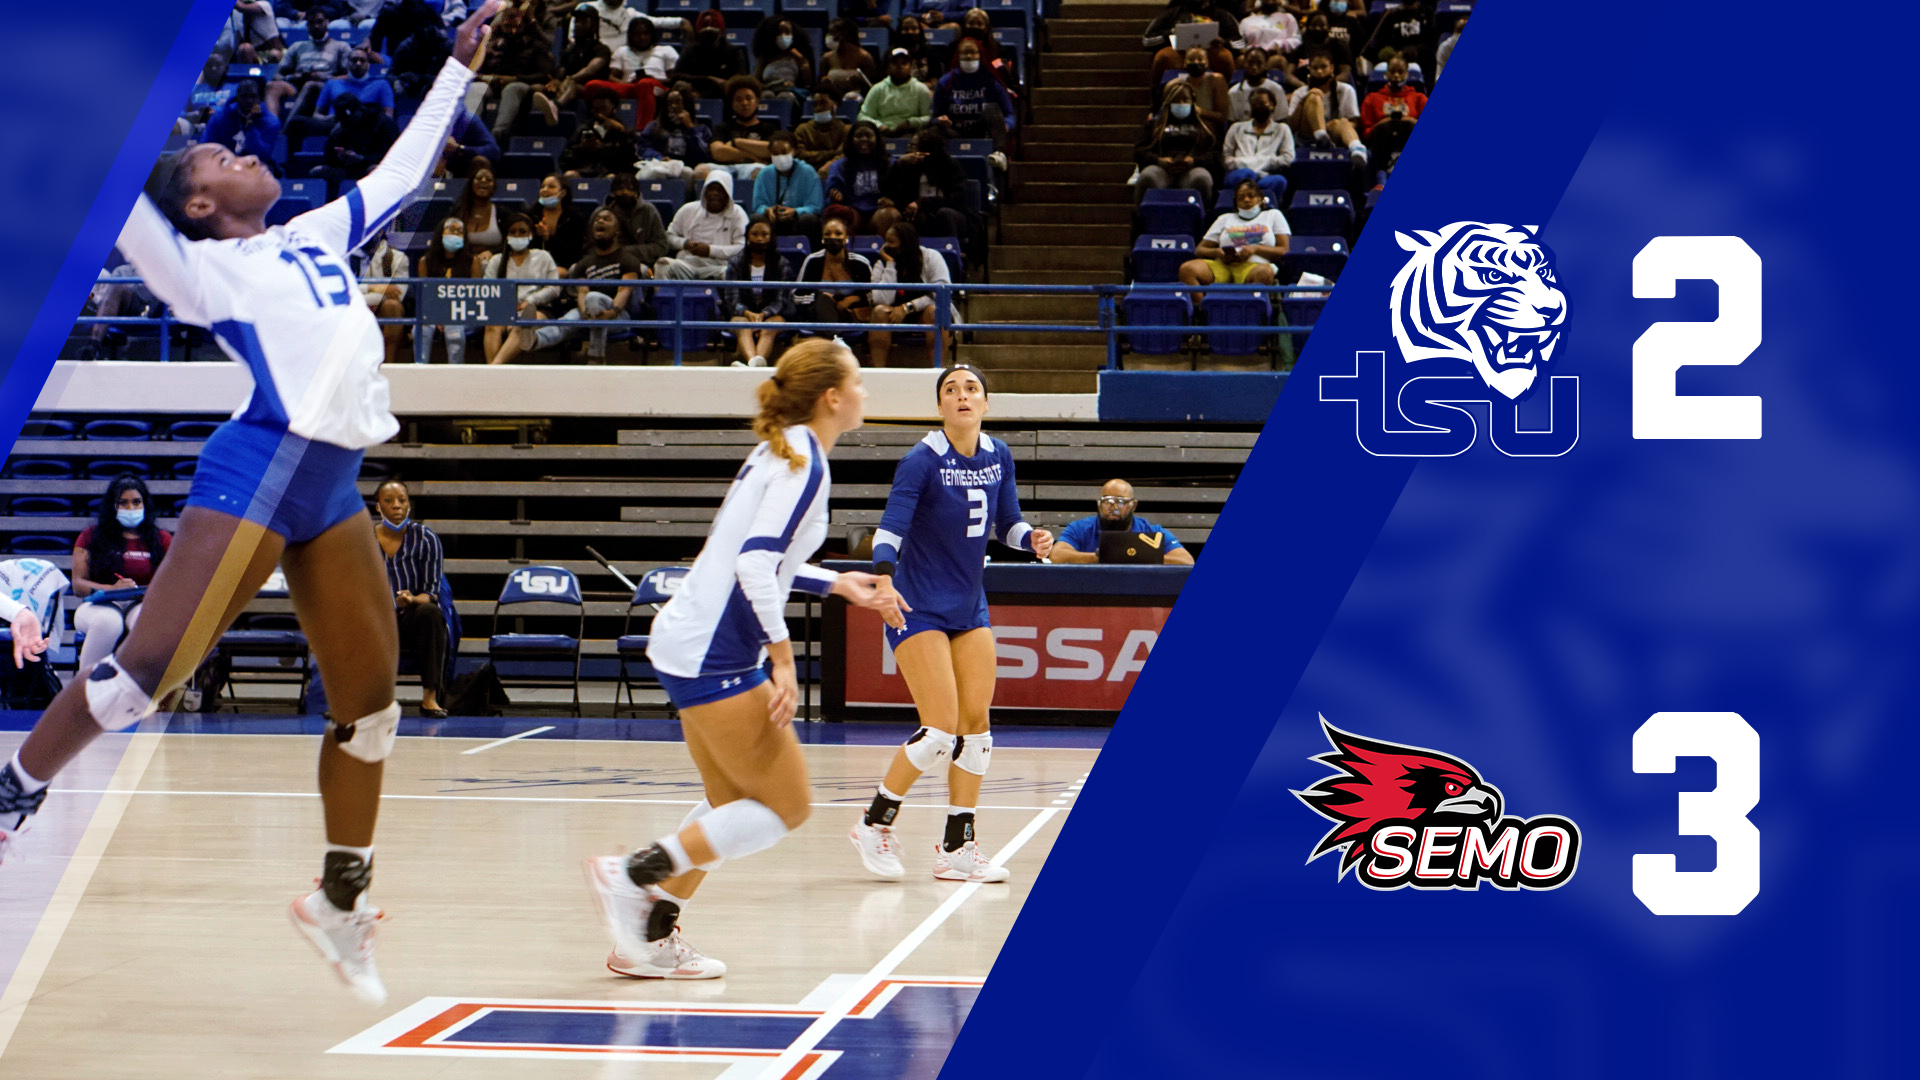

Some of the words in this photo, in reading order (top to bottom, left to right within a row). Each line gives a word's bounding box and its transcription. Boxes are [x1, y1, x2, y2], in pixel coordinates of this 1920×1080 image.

[952, 87, 986, 99] TREAT
[280, 246, 351, 308] 15
[438, 285, 500, 298] SECTION
[451, 300, 489, 320] H-1
[966, 488, 988, 538] 3
[648, 571, 684, 595] ts
[881, 622, 1158, 682] SSA
